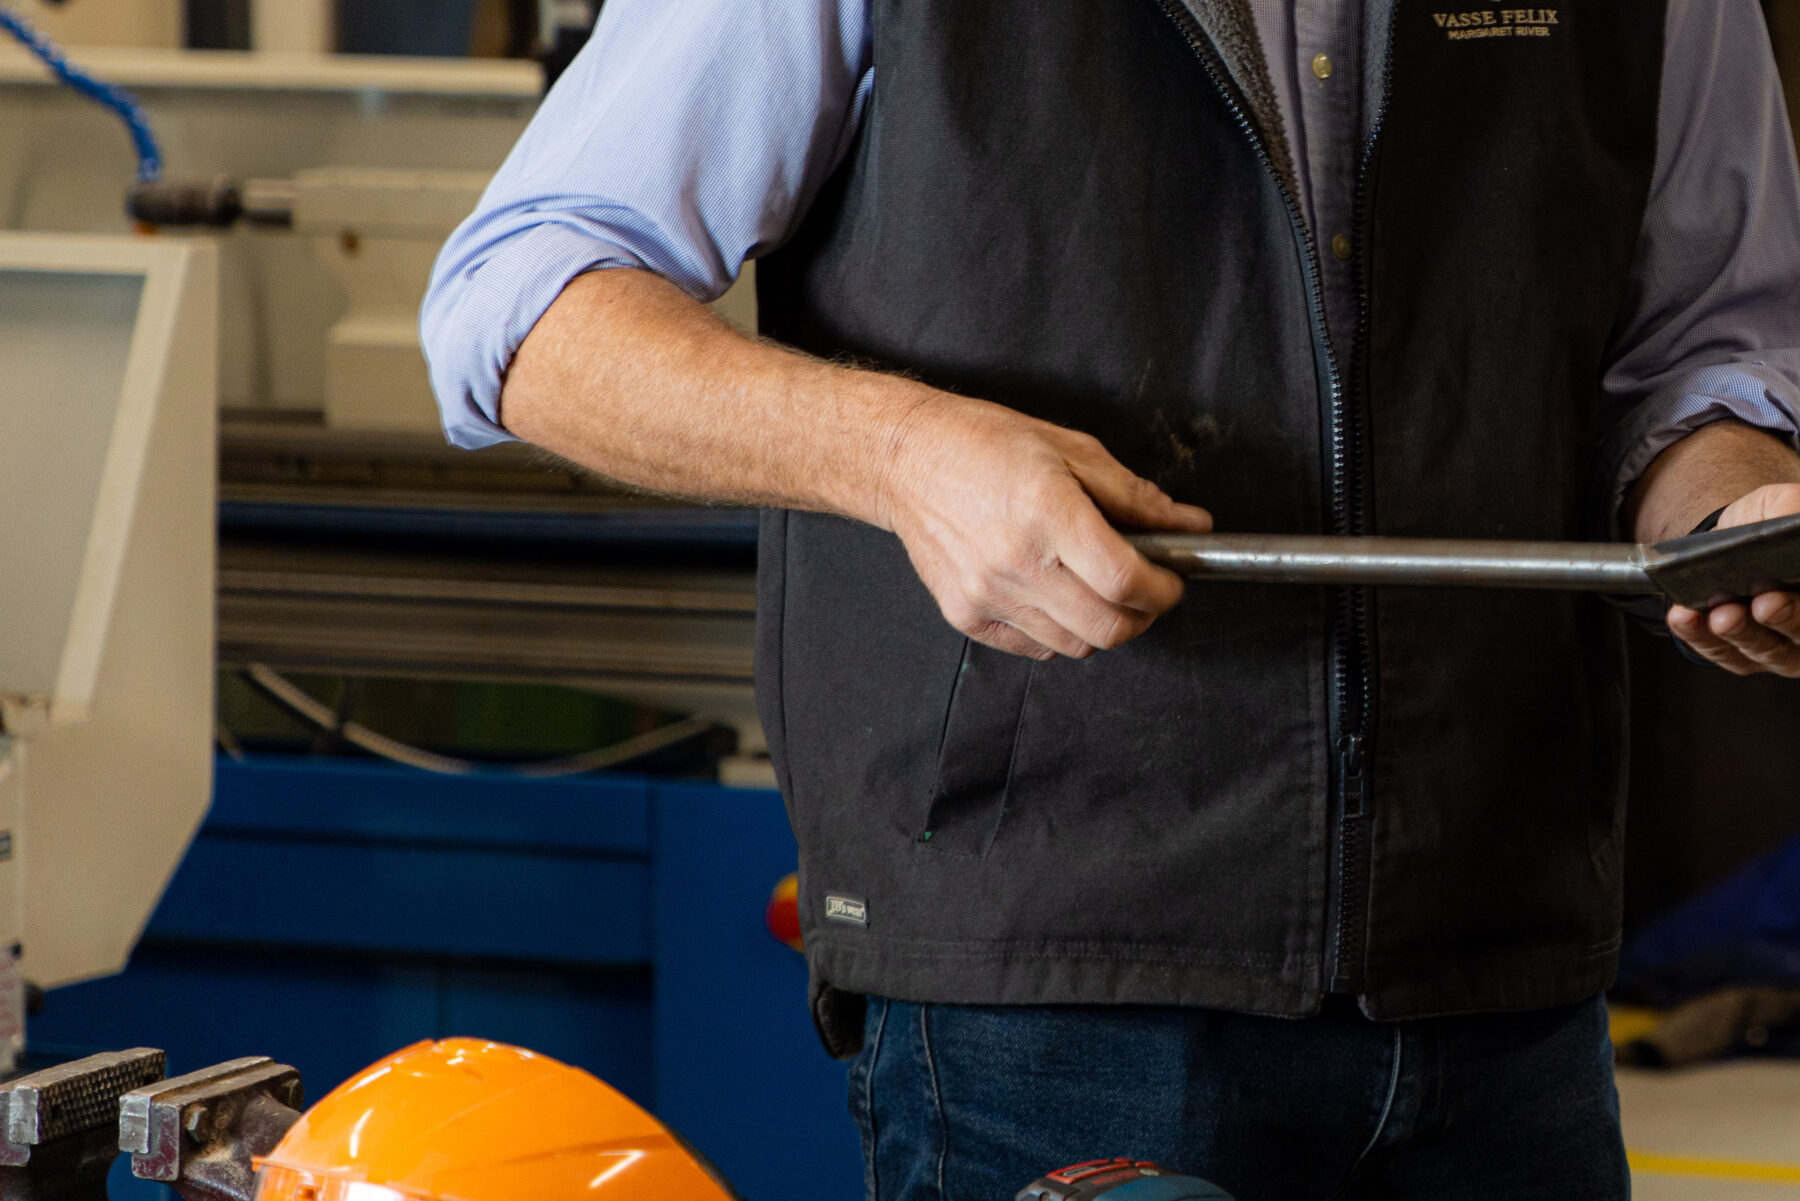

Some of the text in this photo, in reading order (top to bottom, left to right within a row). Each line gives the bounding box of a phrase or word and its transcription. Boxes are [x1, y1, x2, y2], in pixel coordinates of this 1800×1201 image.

[1432, 9, 1559, 28] VASSE FELIX
[1448, 26, 1550, 40] MARGARET RIVER
